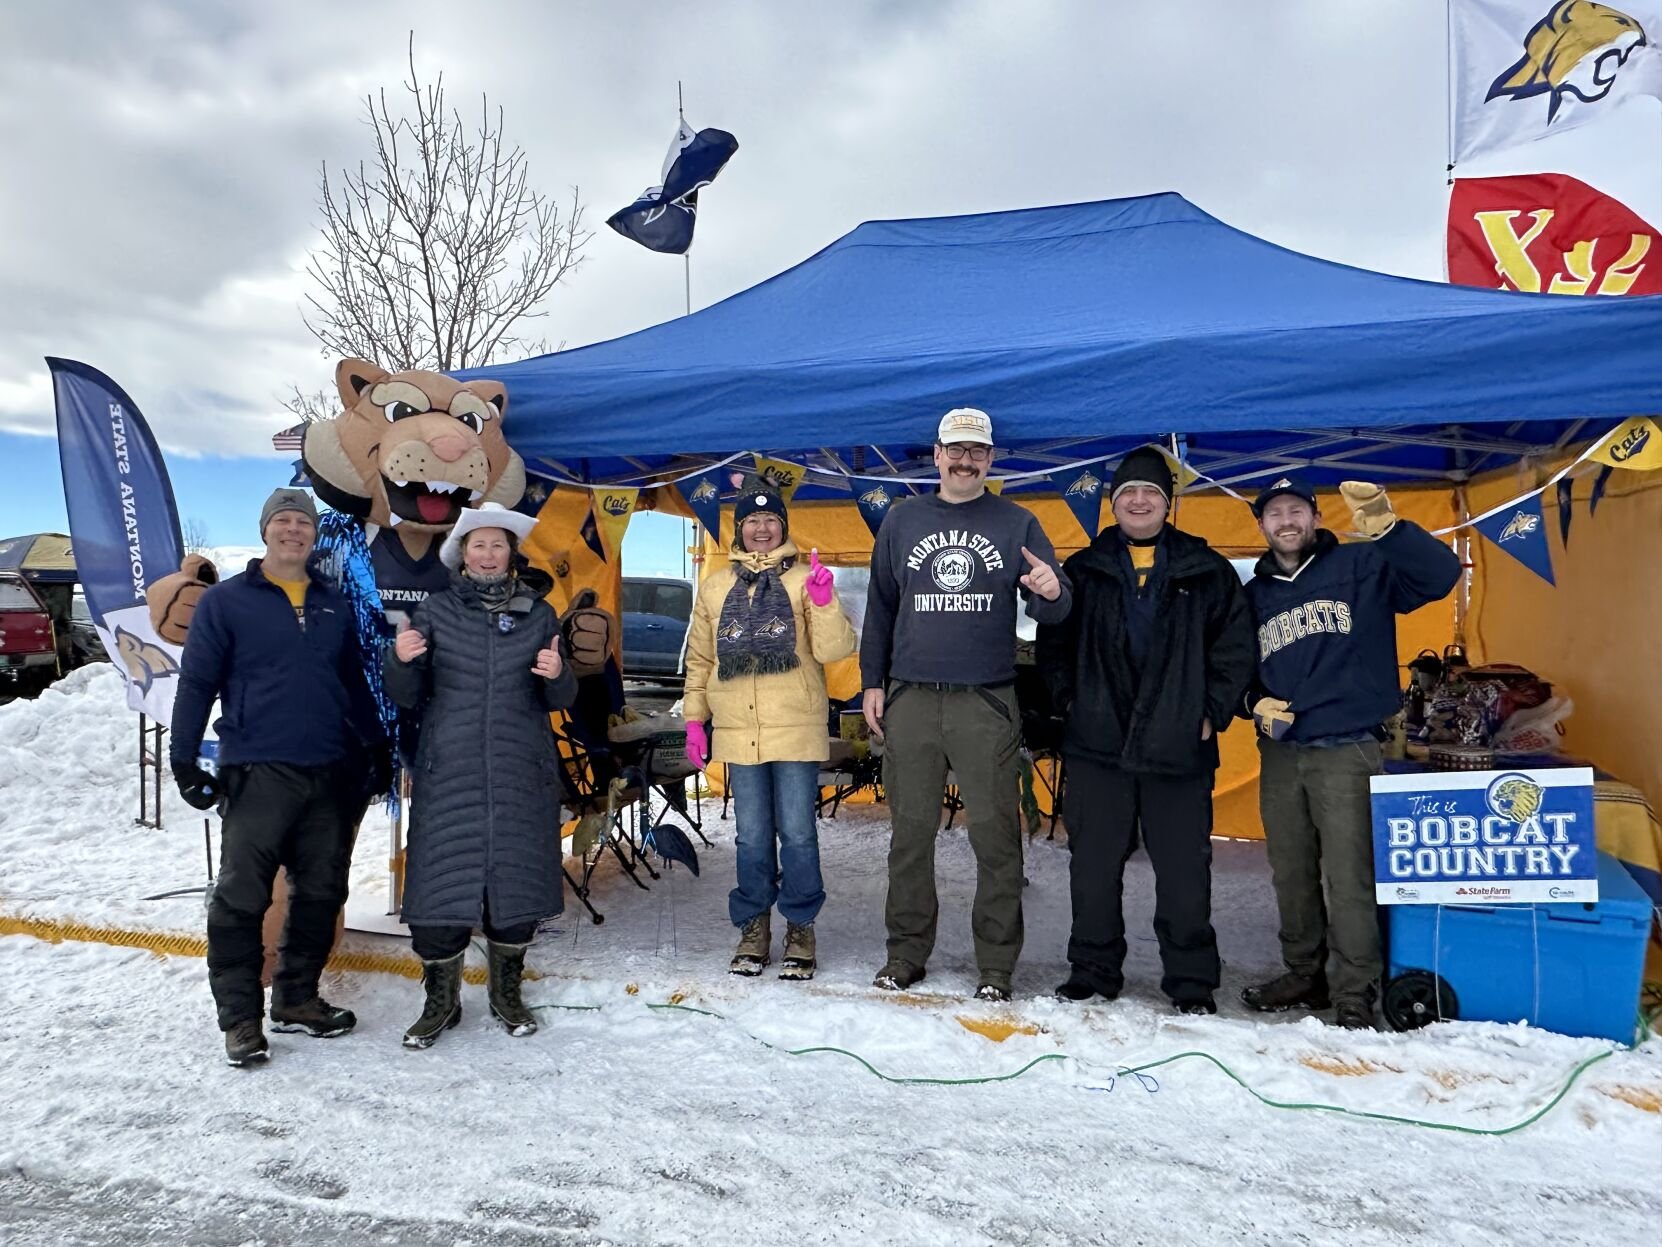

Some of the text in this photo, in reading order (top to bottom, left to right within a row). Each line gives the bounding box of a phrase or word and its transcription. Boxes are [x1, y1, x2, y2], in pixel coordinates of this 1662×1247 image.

[1610, 424, 1650, 462] Cats
[603, 495, 631, 513] Cats
[907, 530, 967, 572] MONTANA
[968, 533, 1004, 573] STATE
[376, 589, 430, 602] NTANA
[914, 593, 994, 612] UNIVERSITY
[1257, 600, 1352, 662] BOBCATS
[1408, 795, 1457, 815] This is
[1388, 812, 1576, 848] BOBCAT
[1389, 845, 1580, 878] COUNTRY
